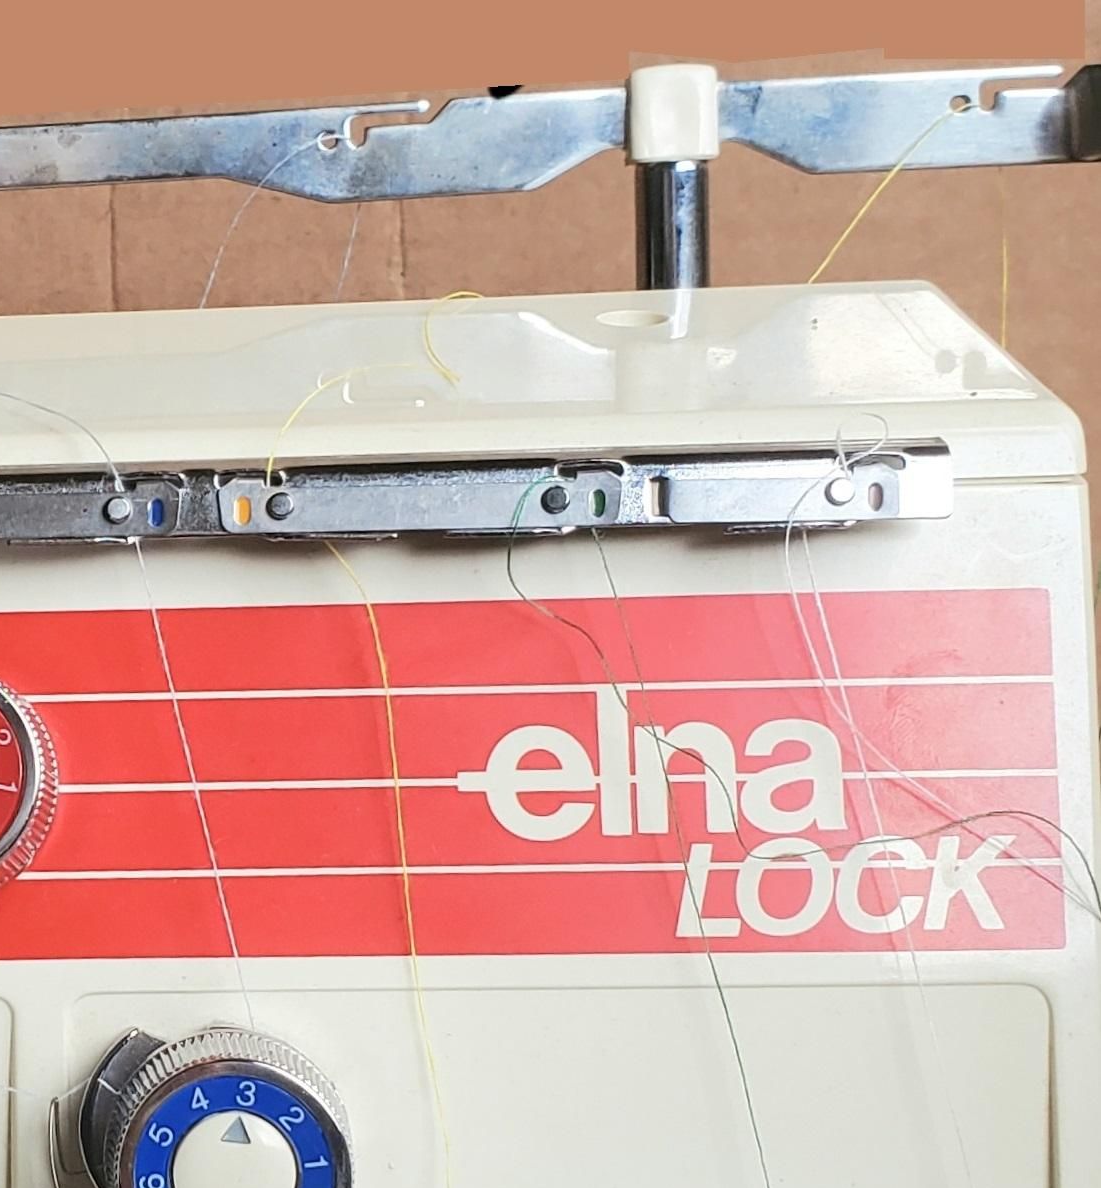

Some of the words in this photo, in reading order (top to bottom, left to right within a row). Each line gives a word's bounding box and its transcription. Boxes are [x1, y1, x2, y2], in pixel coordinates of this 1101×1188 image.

[484, 686, 848, 842] elna
[675, 834, 1017, 938] LOCK
[191, 1087, 209, 1111] 4
[236, 1081, 256, 1106] 3
[279, 1107, 304, 1132] 2
[149, 1122, 173, 1147] 5
[304, 1156, 328, 1169] 1
